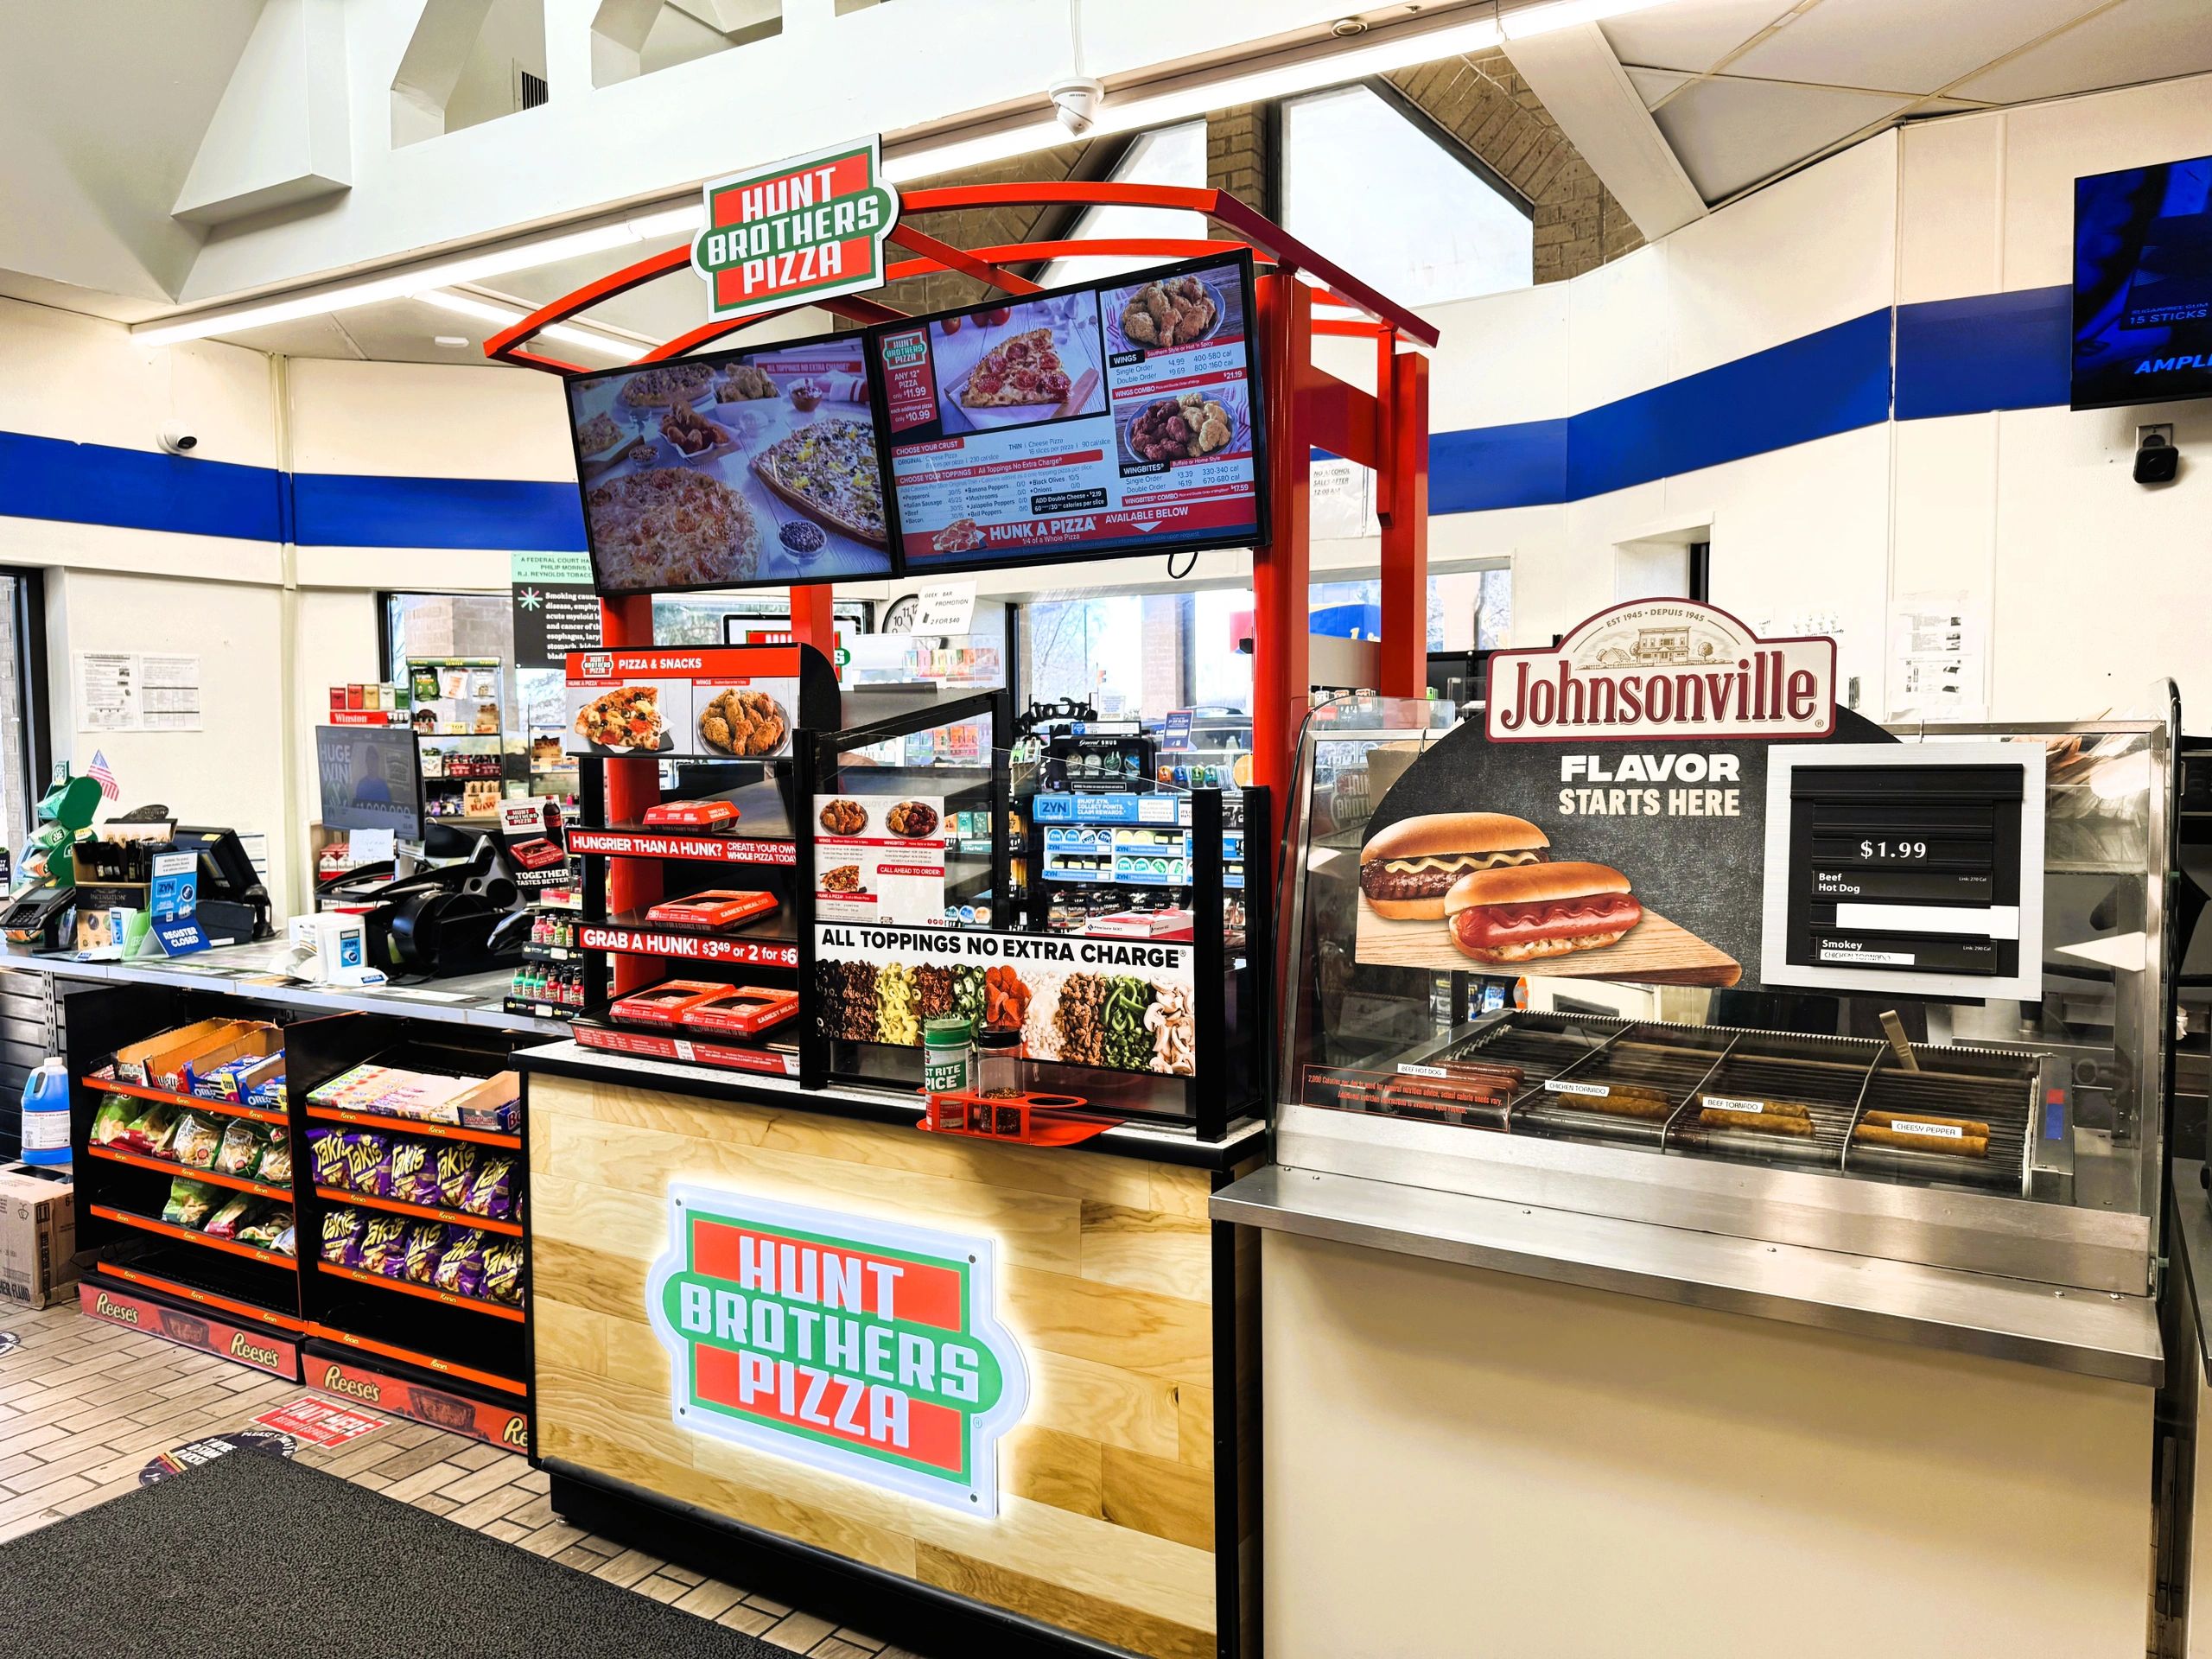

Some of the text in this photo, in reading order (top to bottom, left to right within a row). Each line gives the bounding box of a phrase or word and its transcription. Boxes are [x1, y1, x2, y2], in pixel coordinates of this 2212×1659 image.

[741, 167, 836, 224] HUNT
[708, 194, 879, 266] BROTHERS
[743, 240, 842, 294] PIZZA
[2150, 309, 2207, 321] STICKS
[893, 338, 913, 346] HUNT
[886, 345, 924, 357] BROTHERS
[895, 353, 916, 364] PIZZA
[1114, 354, 1137, 365] WINGS
[894, 372, 908, 380] ANY
[1116, 375, 1136, 385] Double
[899, 378, 918, 389] PIZZA
[903, 387, 926, 397] $11.99
[1115, 385, 1155, 397] WINGS COMBO
[906, 410, 931, 422] $10.99
[896, 441, 958, 455] CHOOSE YOUR CRUST
[899, 474, 924, 484] CHOOSE
[942, 469, 971, 480] TOPPINGS
[985, 463, 1012, 474] Toppings
[1022, 459, 1037, 467] Extra
[1125, 477, 1144, 486] Single
[1126, 485, 1147, 493] Double
[1105, 506, 1189, 524] AVAILABLE BELOW
[990, 518, 1096, 541] HUNK A PIZZA
[545, 592, 576, 601] Smoking
[902, 607, 909, 617] 11
[1607, 608, 1706, 628] EST 1945 DEPUIS 1945
[894, 616, 903, 626] 10
[619, 658, 702, 670] PIZZA & SNACKS
[1501, 651, 1818, 732] Johnsonville
[334, 714, 368, 723] Winston
[319, 743, 350, 762] HUGE
[1560, 753, 1741, 783] FLAVOR
[1042, 802, 1067, 813] ZYN
[1558, 788, 1740, 817] STARTS HERE
[572, 835, 722, 857] HUNGRIER THAN A HUNK?
[727, 842, 777, 853] CREATE YOUR
[1860, 840, 1927, 859] $1.99
[727, 851, 773, 861] WHOLE PIZZA
[515, 869, 569, 880] TOGETHER
[1819, 873, 1842, 882] Beef
[159, 883, 173, 893] ZYN
[1818, 883, 1860, 894] Hot Dog
[162, 927, 198, 940] REGISTER
[171, 936, 199, 947] CLOSED
[583, 930, 777, 961] GRAB A HUNK! or 2 for
[1822, 940, 1862, 950] Smokey
[822, 928, 1179, 969] ALL TOPPINGS NO EXTRA CHARGE
[757, 1012, 781, 1024] EASIEST
[936, 1065, 960, 1077] RITE
[1548, 1083, 1573, 1091] CHICKEN
[194, 1088, 272, 1106] OREO OREO
[1384, 1083, 1502, 1106] general vary.
[1707, 1098, 1725, 1108] BEEF
[1896, 1123, 1956, 1136] CHEESY PEPPER
[344, 1135, 427, 1183] Takis Takis
[739, 1235, 904, 1323] HUNT
[11, 1282, 30, 1301] FLUID
[96, 1292, 138, 1324] Reese's
[680, 1281, 979, 1403] BROTHERS
[230, 1332, 279, 1369] Reese's
[323, 1364, 381, 1402] Reese's
[739, 1349, 910, 1449] PIZZA
